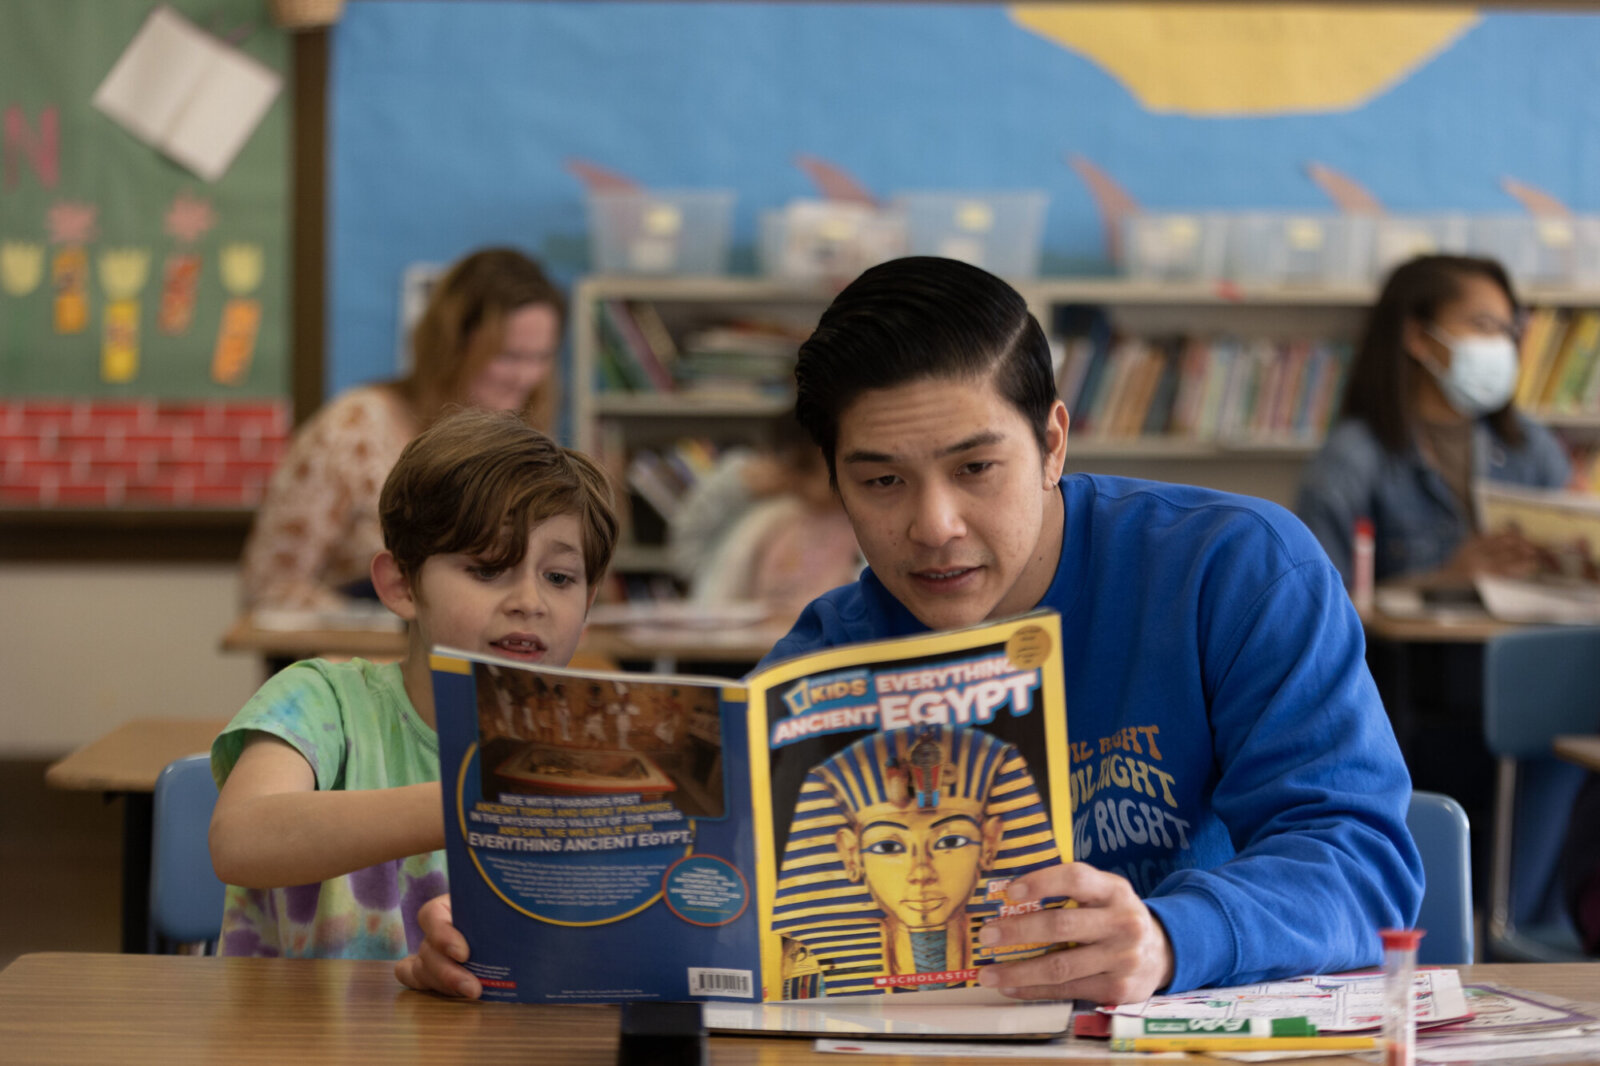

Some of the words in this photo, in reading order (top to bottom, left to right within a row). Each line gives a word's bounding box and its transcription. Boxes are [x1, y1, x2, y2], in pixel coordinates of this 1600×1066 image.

[4, 105, 60, 190] N
[810, 678, 867, 704] KIDS
[880, 671, 1037, 731] EGYPT
[773, 704, 879, 745] ANCIENT
[1096, 754, 1178, 808] RIGHT
[470, 811, 481, 821] IN
[482, 813, 502, 824] THE
[503, 816, 567, 828] MYSTERIOUS
[567, 816, 609, 828] VALLEY
[610, 816, 624, 825] OF
[625, 814, 647, 823] THE
[648, 811, 682, 821] KINGS
[476, 802, 518, 815] ANCIENT
[557, 807, 579, 818] AND
[581, 807, 614, 817] GREAT
[616, 802, 672, 814] PYRAMIDS
[498, 826, 520, 837] AND
[521, 827, 545, 838] SAIL
[545, 828, 566, 838] THE
[597, 826, 623, 836] NILE
[624, 824, 653, 834] WITH
[1094, 798, 1191, 853] RIGHT
[468, 832, 562, 852] EVERYTHING
[563, 834, 635, 852] ANCIENT
[638, 830, 694, 847] EGYPT.
[889, 970, 977, 985] SCHOLASTIC
